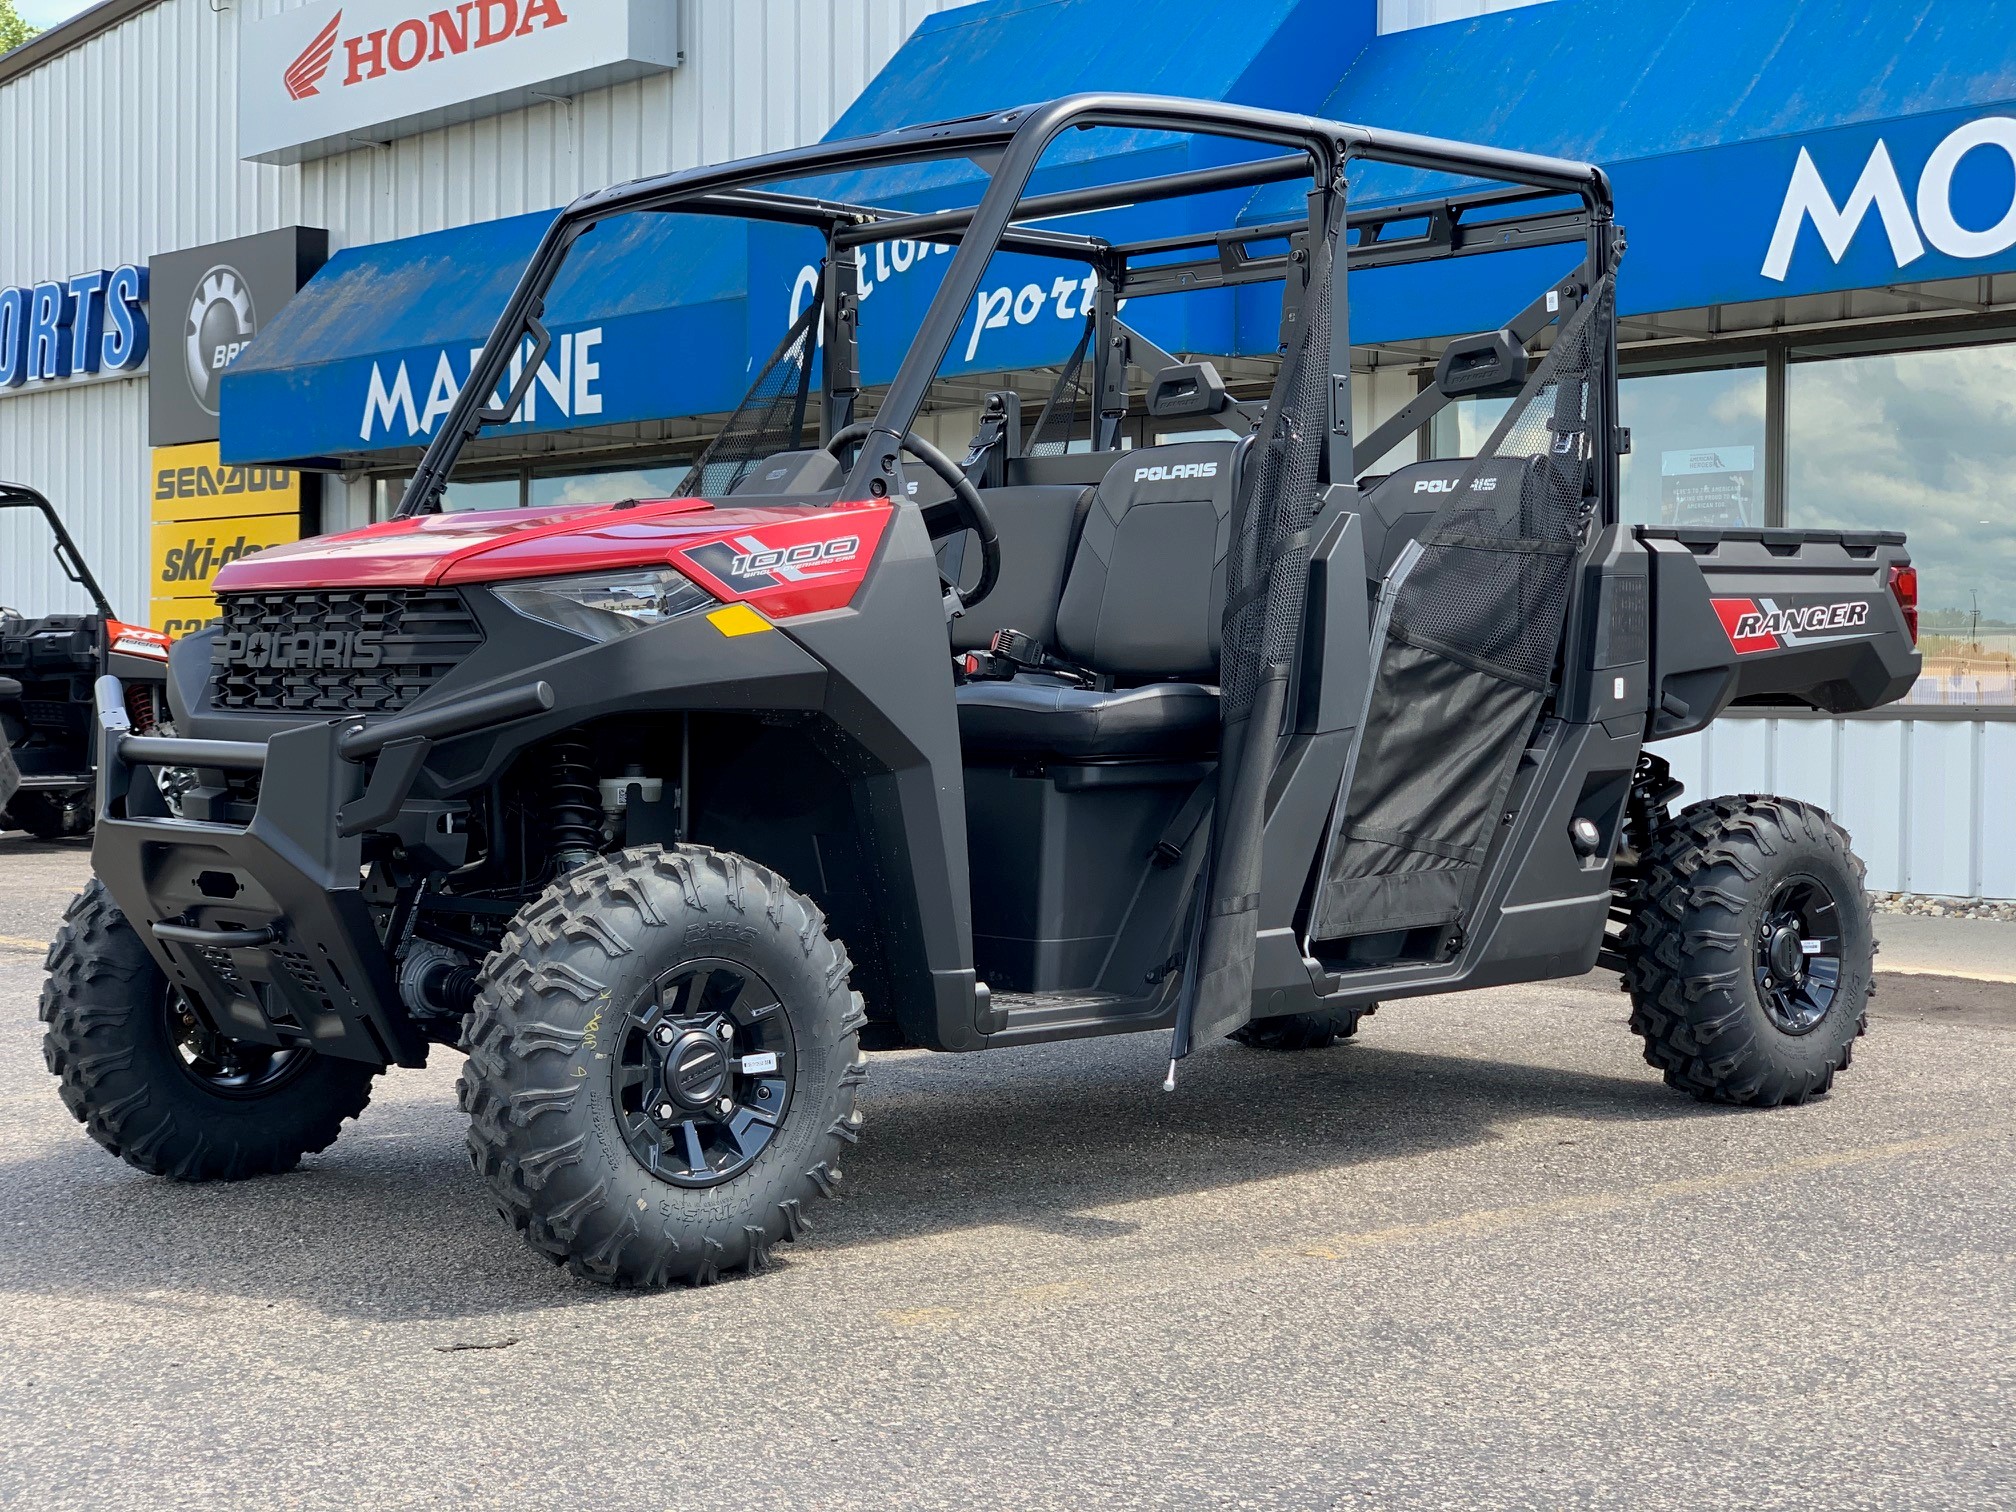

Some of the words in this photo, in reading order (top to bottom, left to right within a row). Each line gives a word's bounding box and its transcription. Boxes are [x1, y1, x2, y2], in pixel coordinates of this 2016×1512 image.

[343, 0, 568, 86] HONDA
[1760, 116, 2016, 282] MO
[0, 264, 149, 387] ORTS
[1134, 462, 1217, 482] POLARIS
[731, 535, 860, 576] 1000
[743, 566, 779, 579] SINGLE
[783, 558, 833, 572] OVERHEAD
[834, 553, 856, 564] CAM
[117, 627, 166, 640] XP
[1733, 601, 1869, 639] RANGER
[224, 631, 384, 668] POLARIS
